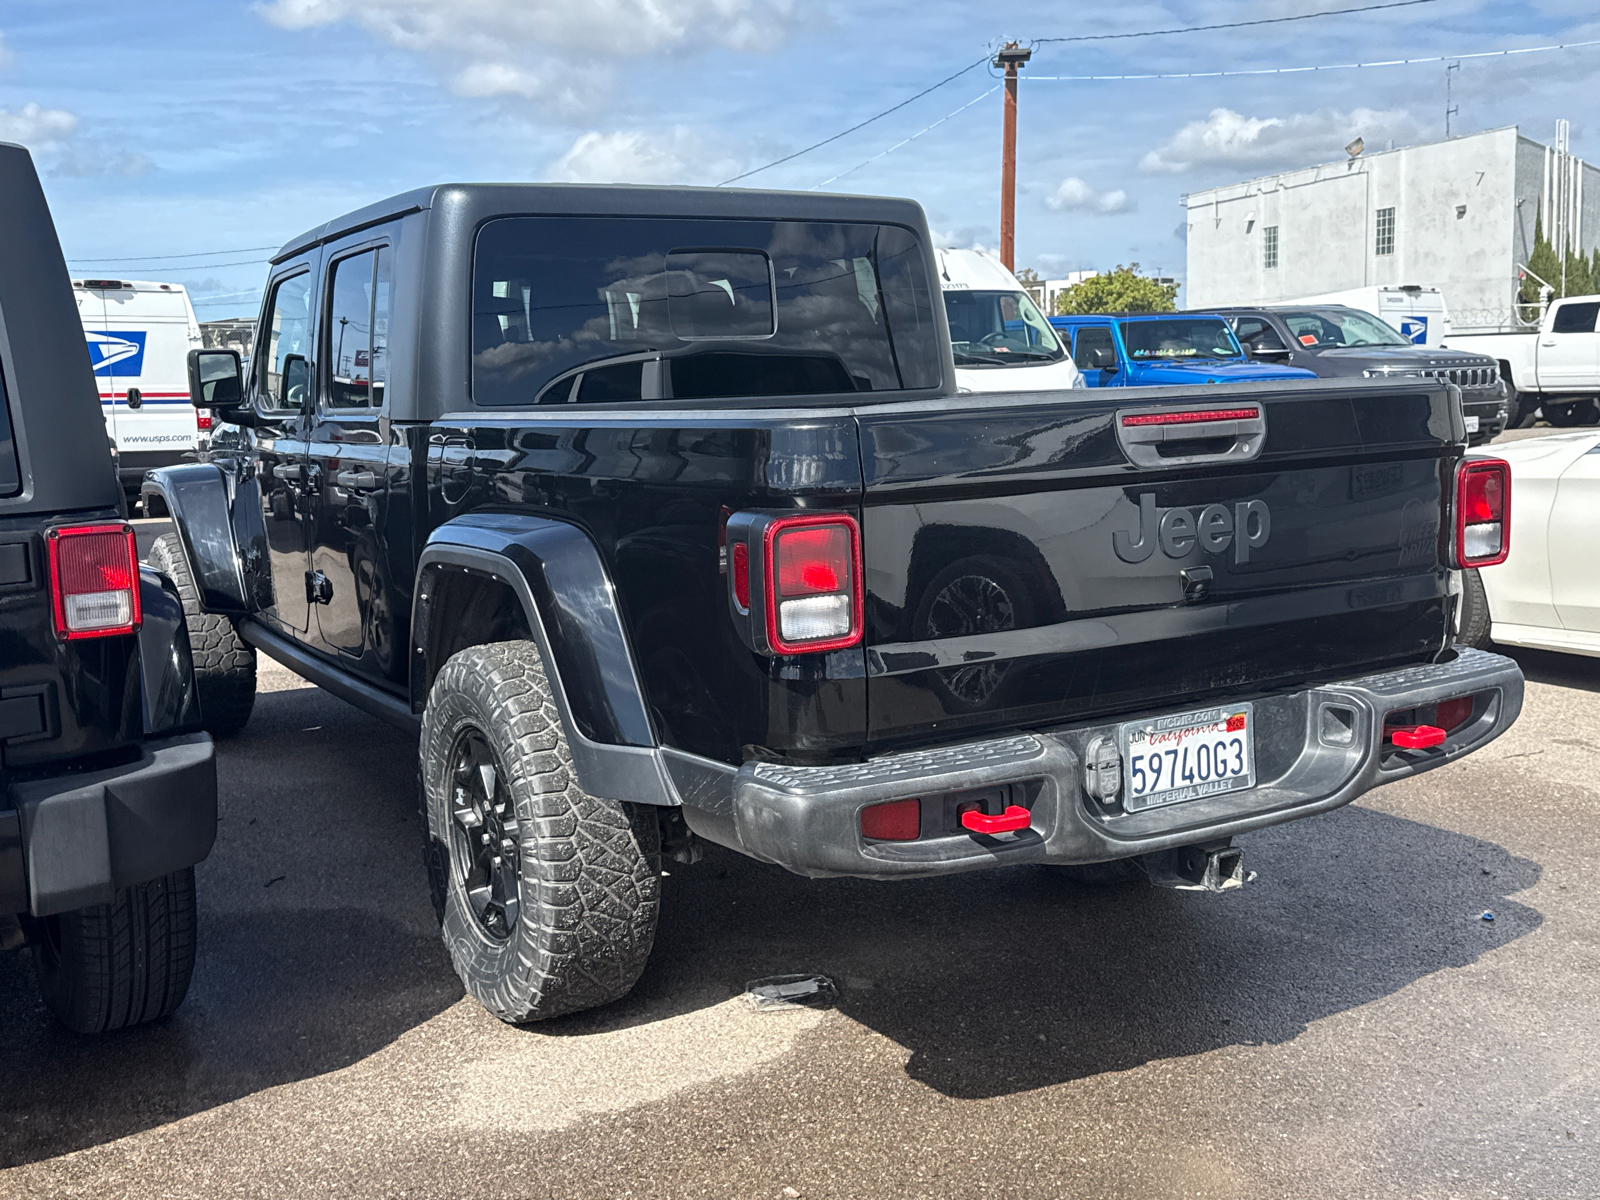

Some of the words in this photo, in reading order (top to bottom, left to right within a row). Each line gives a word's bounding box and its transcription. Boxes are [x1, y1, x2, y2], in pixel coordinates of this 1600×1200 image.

[123, 434, 192, 444] www.usps.com
[1112, 492, 1271, 565] Jeep
[1129, 731, 1146, 744] JUN
[1149, 722, 1222, 746] California
[1131, 737, 1243, 795] 59740G3
[1146, 786, 1195, 805] IMPERIAL
[1196, 778, 1233, 796] VALLEY
